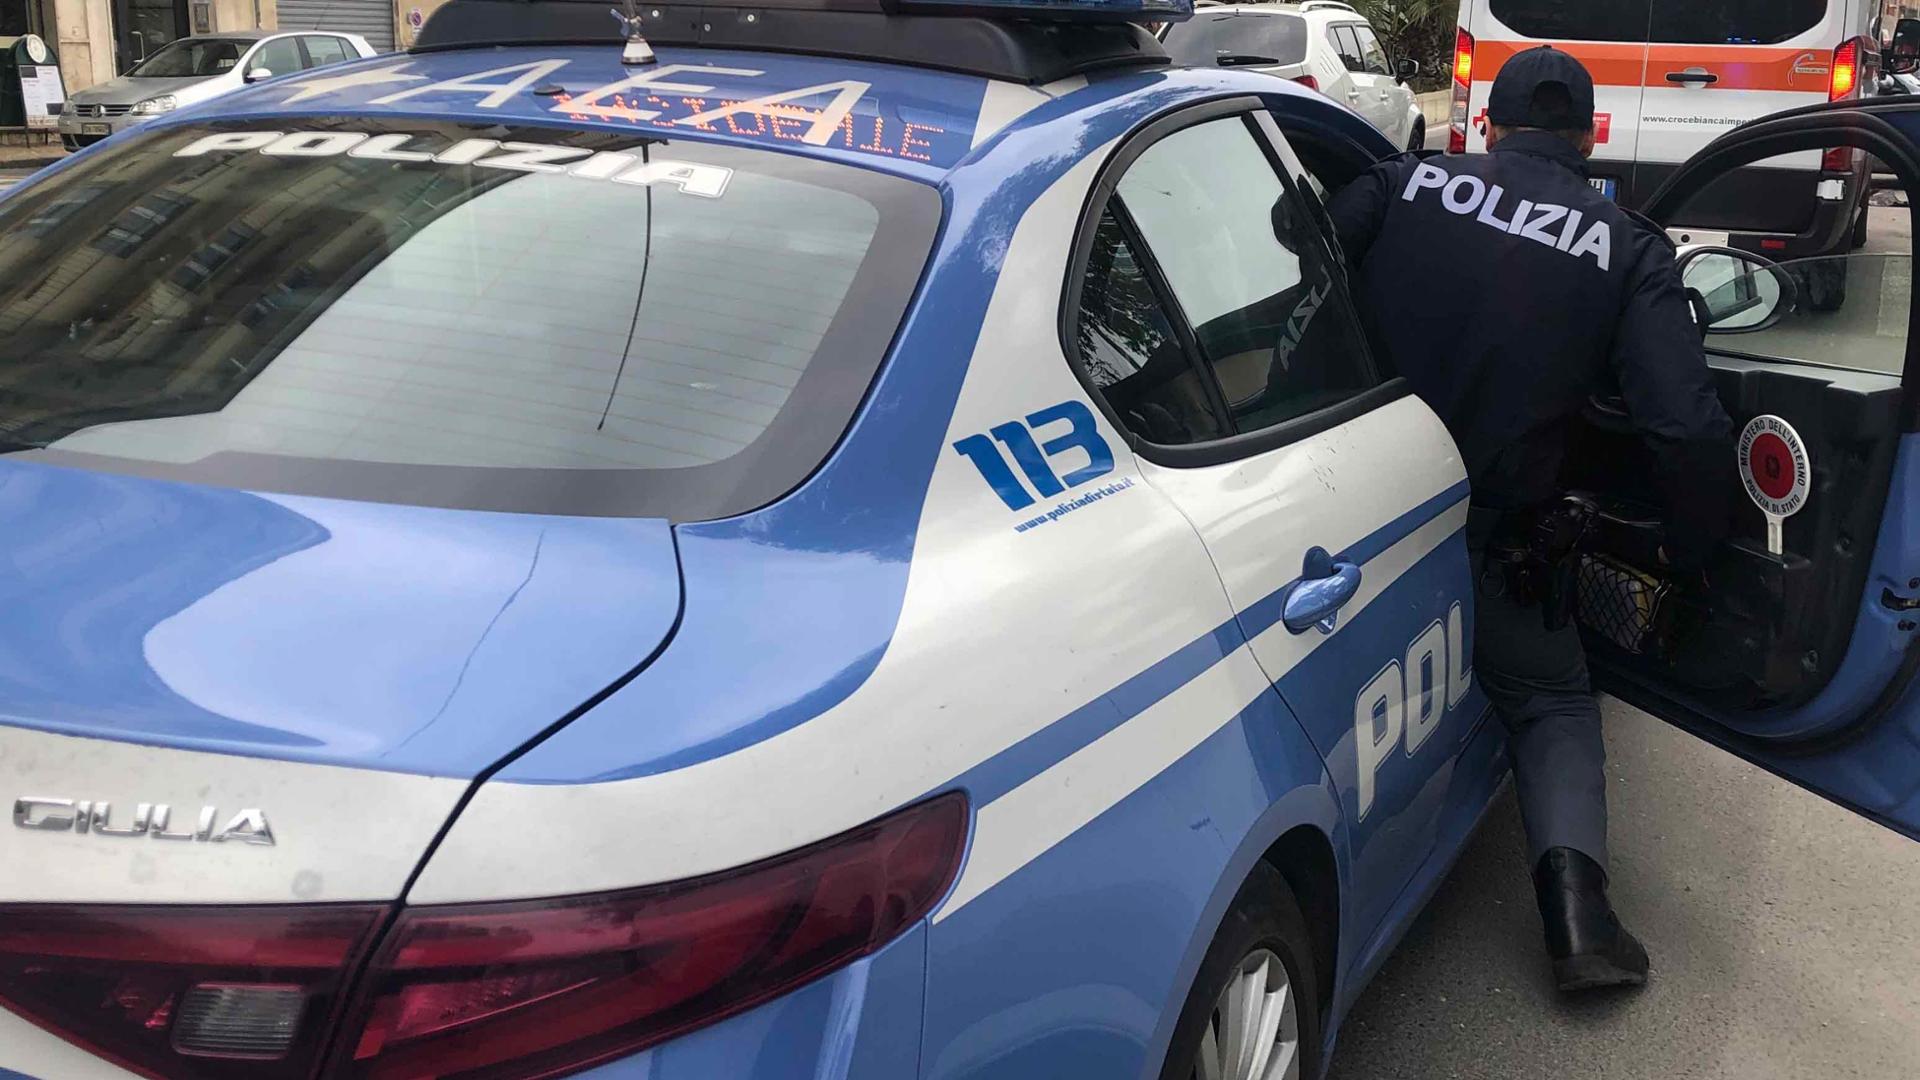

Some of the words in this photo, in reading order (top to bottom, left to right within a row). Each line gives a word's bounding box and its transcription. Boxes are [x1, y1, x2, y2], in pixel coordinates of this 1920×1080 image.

[172, 130, 735, 199] POLIZIA
[1402, 162, 1611, 271] POLIZIA
[953, 400, 1115, 512] 113
[1741, 420, 1766, 466] MINISTERO
[1768, 420, 1806, 486] DELL'INTERNO
[1746, 479, 1769, 510] POLIZIA
[1772, 503, 1780, 513] DI
[1782, 494, 1800, 513] STATO
[13, 796, 276, 847] GIULIA
